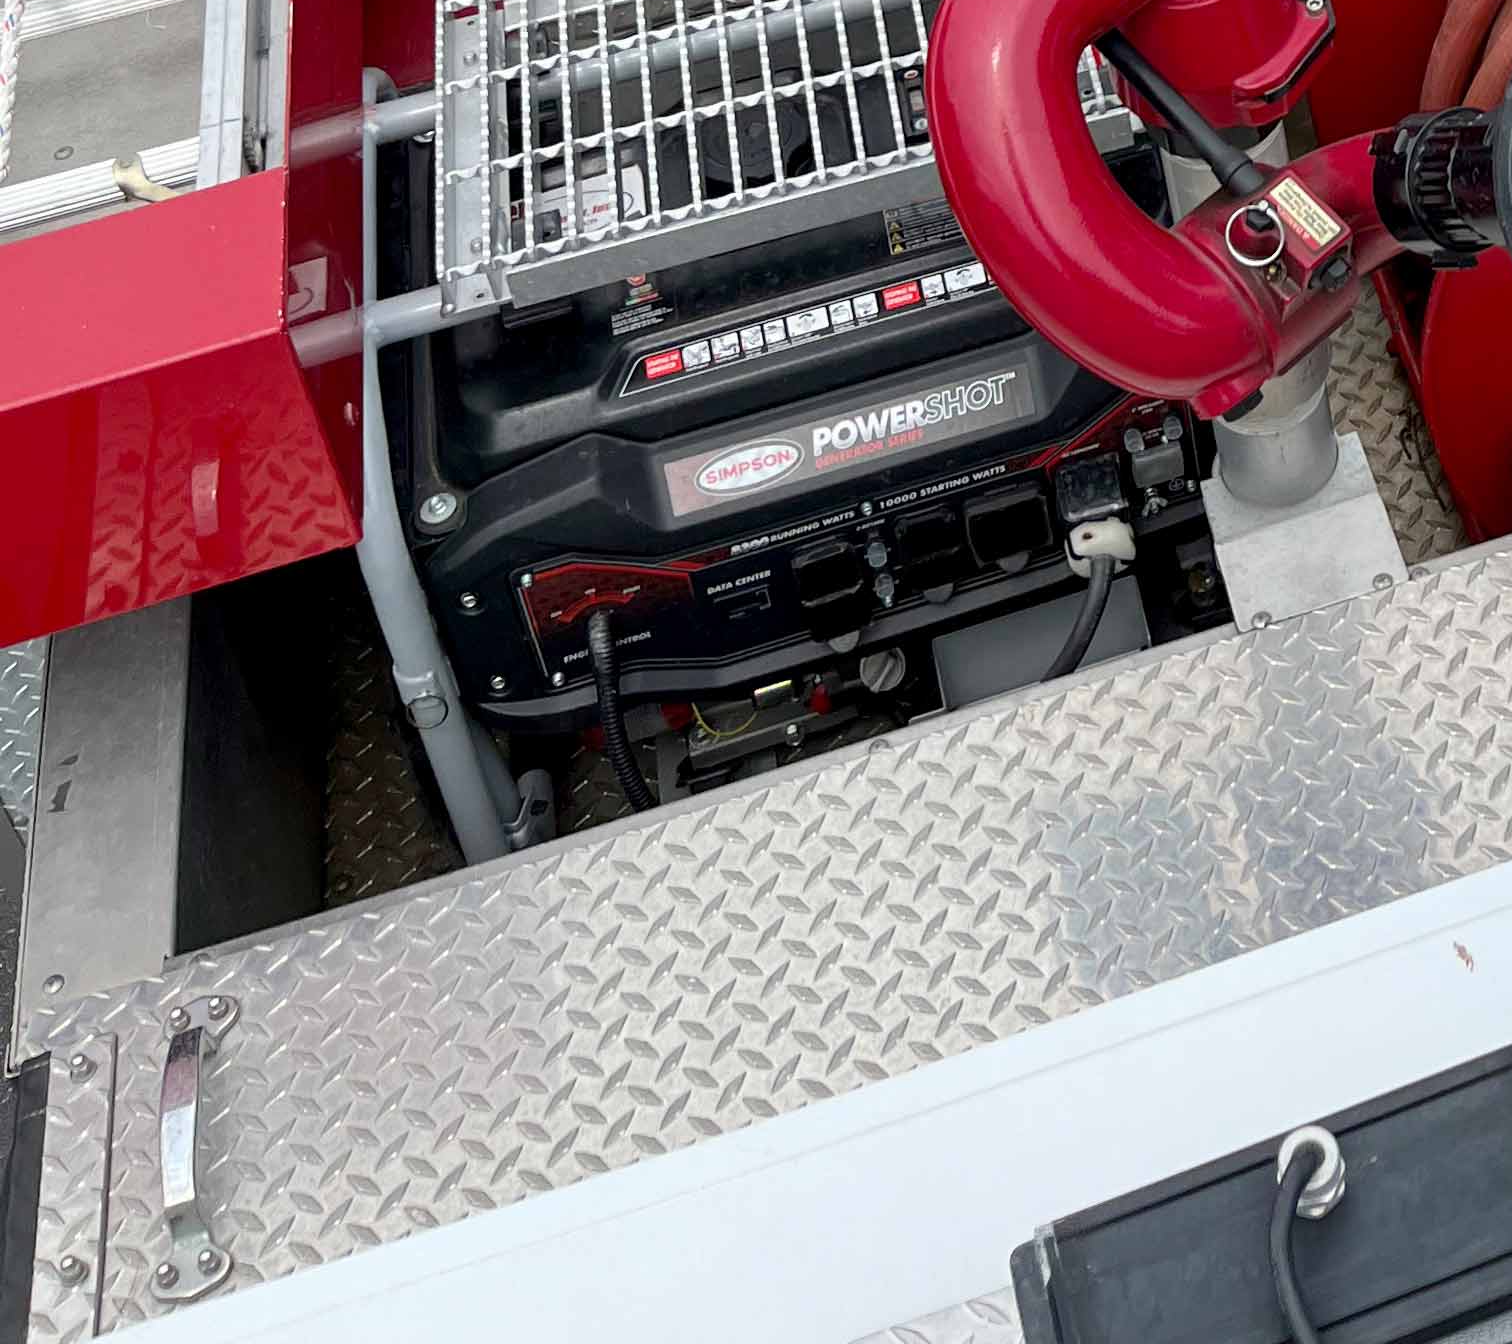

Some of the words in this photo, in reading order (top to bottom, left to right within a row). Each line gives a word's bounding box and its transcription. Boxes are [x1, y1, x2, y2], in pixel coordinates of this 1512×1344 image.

[706, 449, 791, 485] SIMPSON
[879, 491, 917, 510] 10000
[919, 475, 970, 498] STARTING
[972, 464, 1006, 481] WATTS
[770, 522, 820, 543] RUNNING
[822, 511, 855, 526] WATTS
[707, 581, 733, 595] DATA
[735, 569, 771, 587] CENTER
